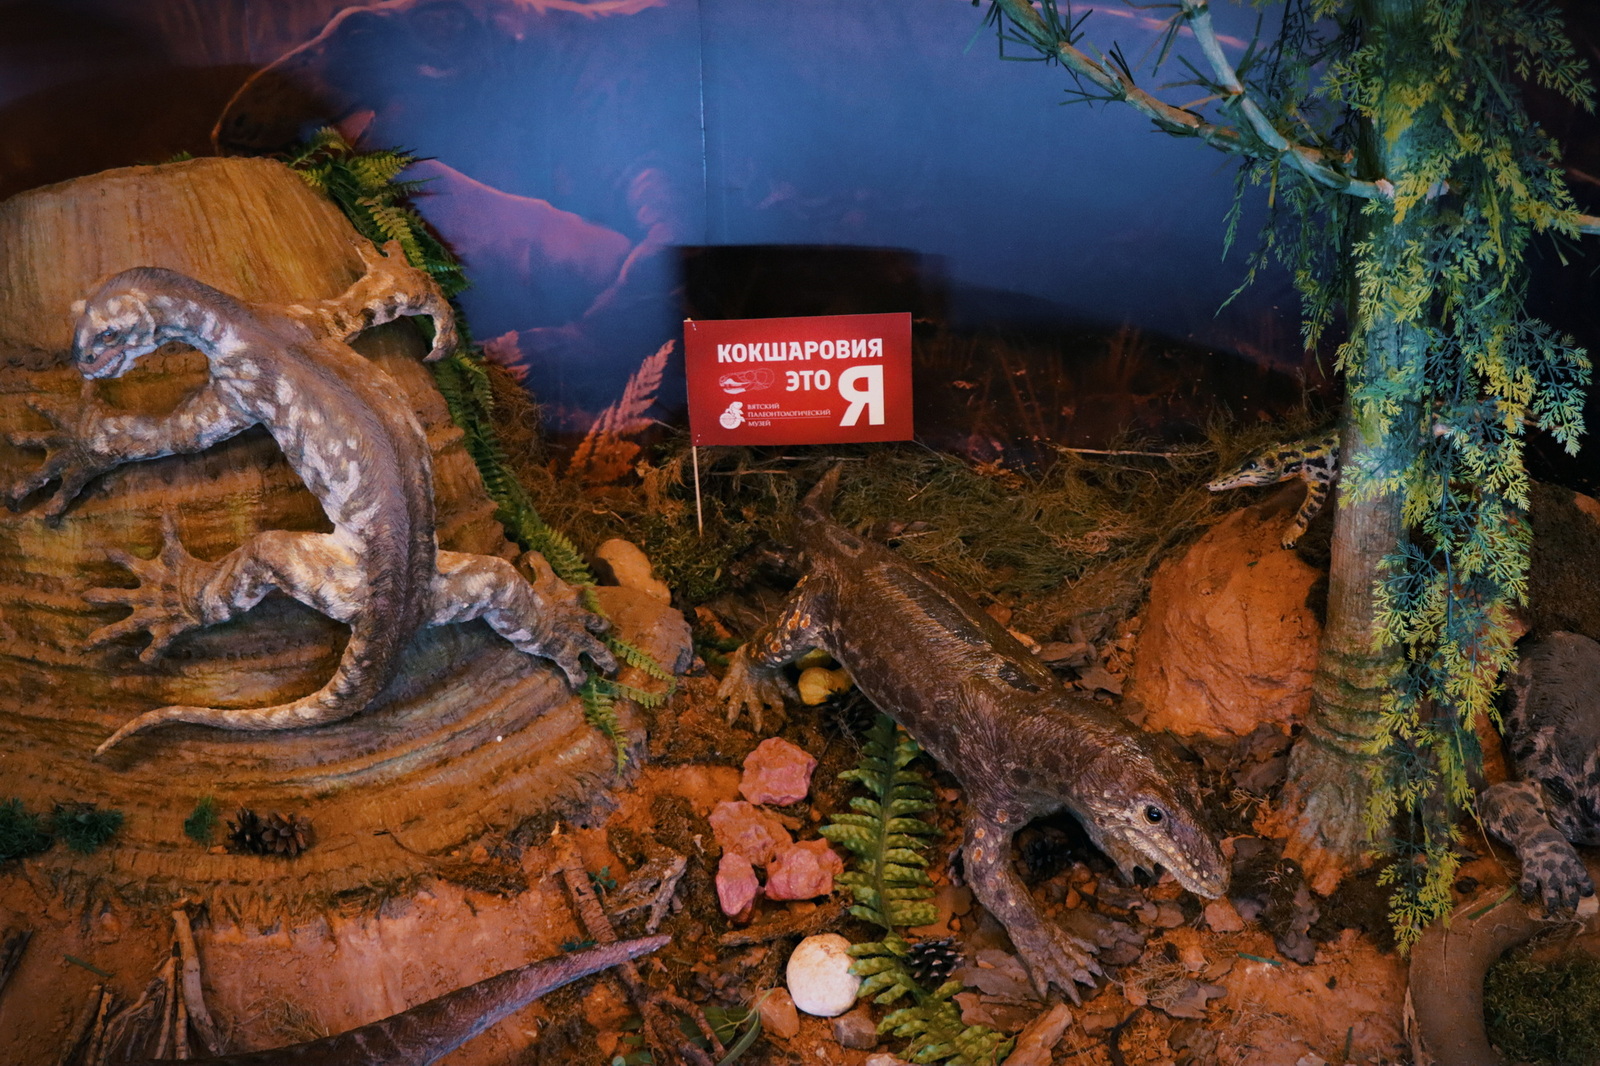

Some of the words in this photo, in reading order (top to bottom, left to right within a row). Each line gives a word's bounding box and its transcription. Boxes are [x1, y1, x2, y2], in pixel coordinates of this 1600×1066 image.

[717, 338, 883, 363] КОКШАРОВИЯ
[785, 369, 831, 392] ЭТО
[838, 364, 885, 427] Я
[747, 402, 780, 410] ВЯТСКИЙ
[747, 408, 831, 418] ПАЛЕОНТОЛОГИЧЕСКИЙ
